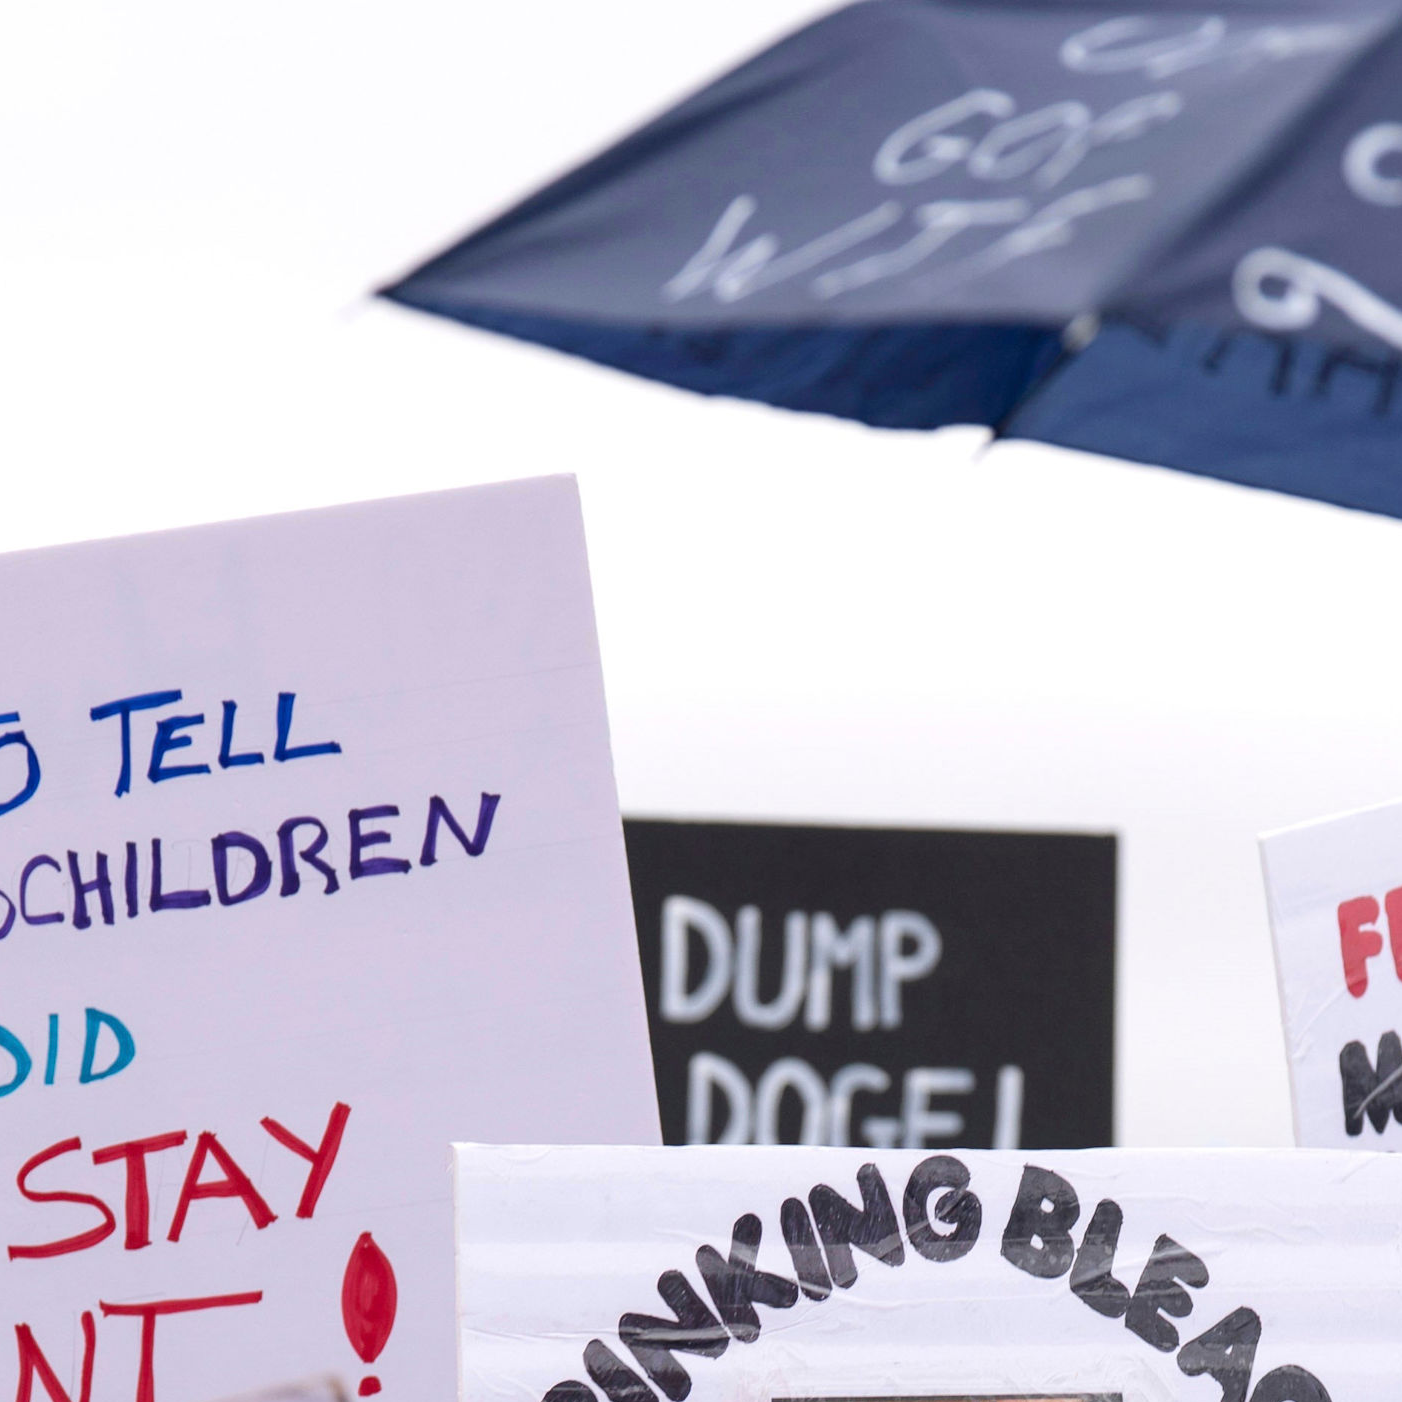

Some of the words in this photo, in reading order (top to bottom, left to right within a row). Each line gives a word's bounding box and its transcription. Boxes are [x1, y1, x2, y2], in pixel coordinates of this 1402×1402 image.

[90, 689, 342, 797] TELL
[660, 895, 942, 1032] DUMP
[7, 1101, 351, 1260] STAY
